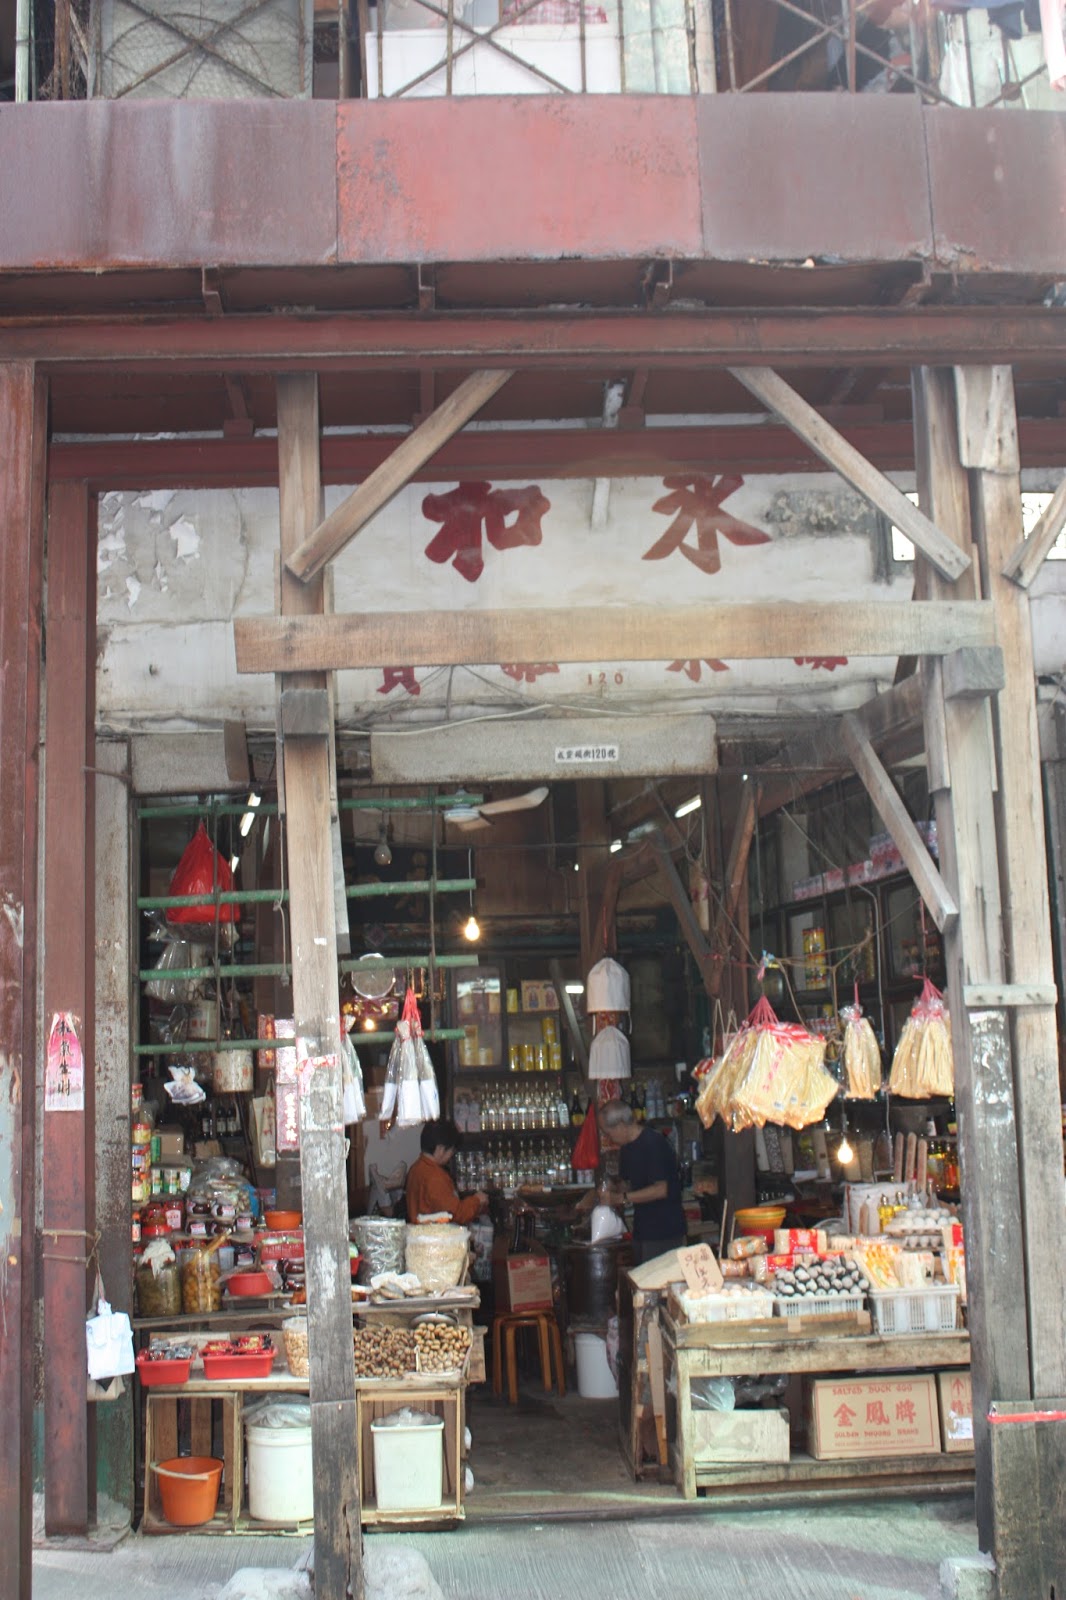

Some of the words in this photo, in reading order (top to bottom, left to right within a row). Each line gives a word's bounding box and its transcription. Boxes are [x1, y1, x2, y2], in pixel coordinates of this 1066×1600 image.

[586, 672, 624, 686] 120
[832, 1385, 863, 1396] SALTED
[868, 1383, 892, 1394] DUCK
[833, 1398, 917, 1428] 金鳳牌
[834, 1431, 860, 1439] GOLDEN
